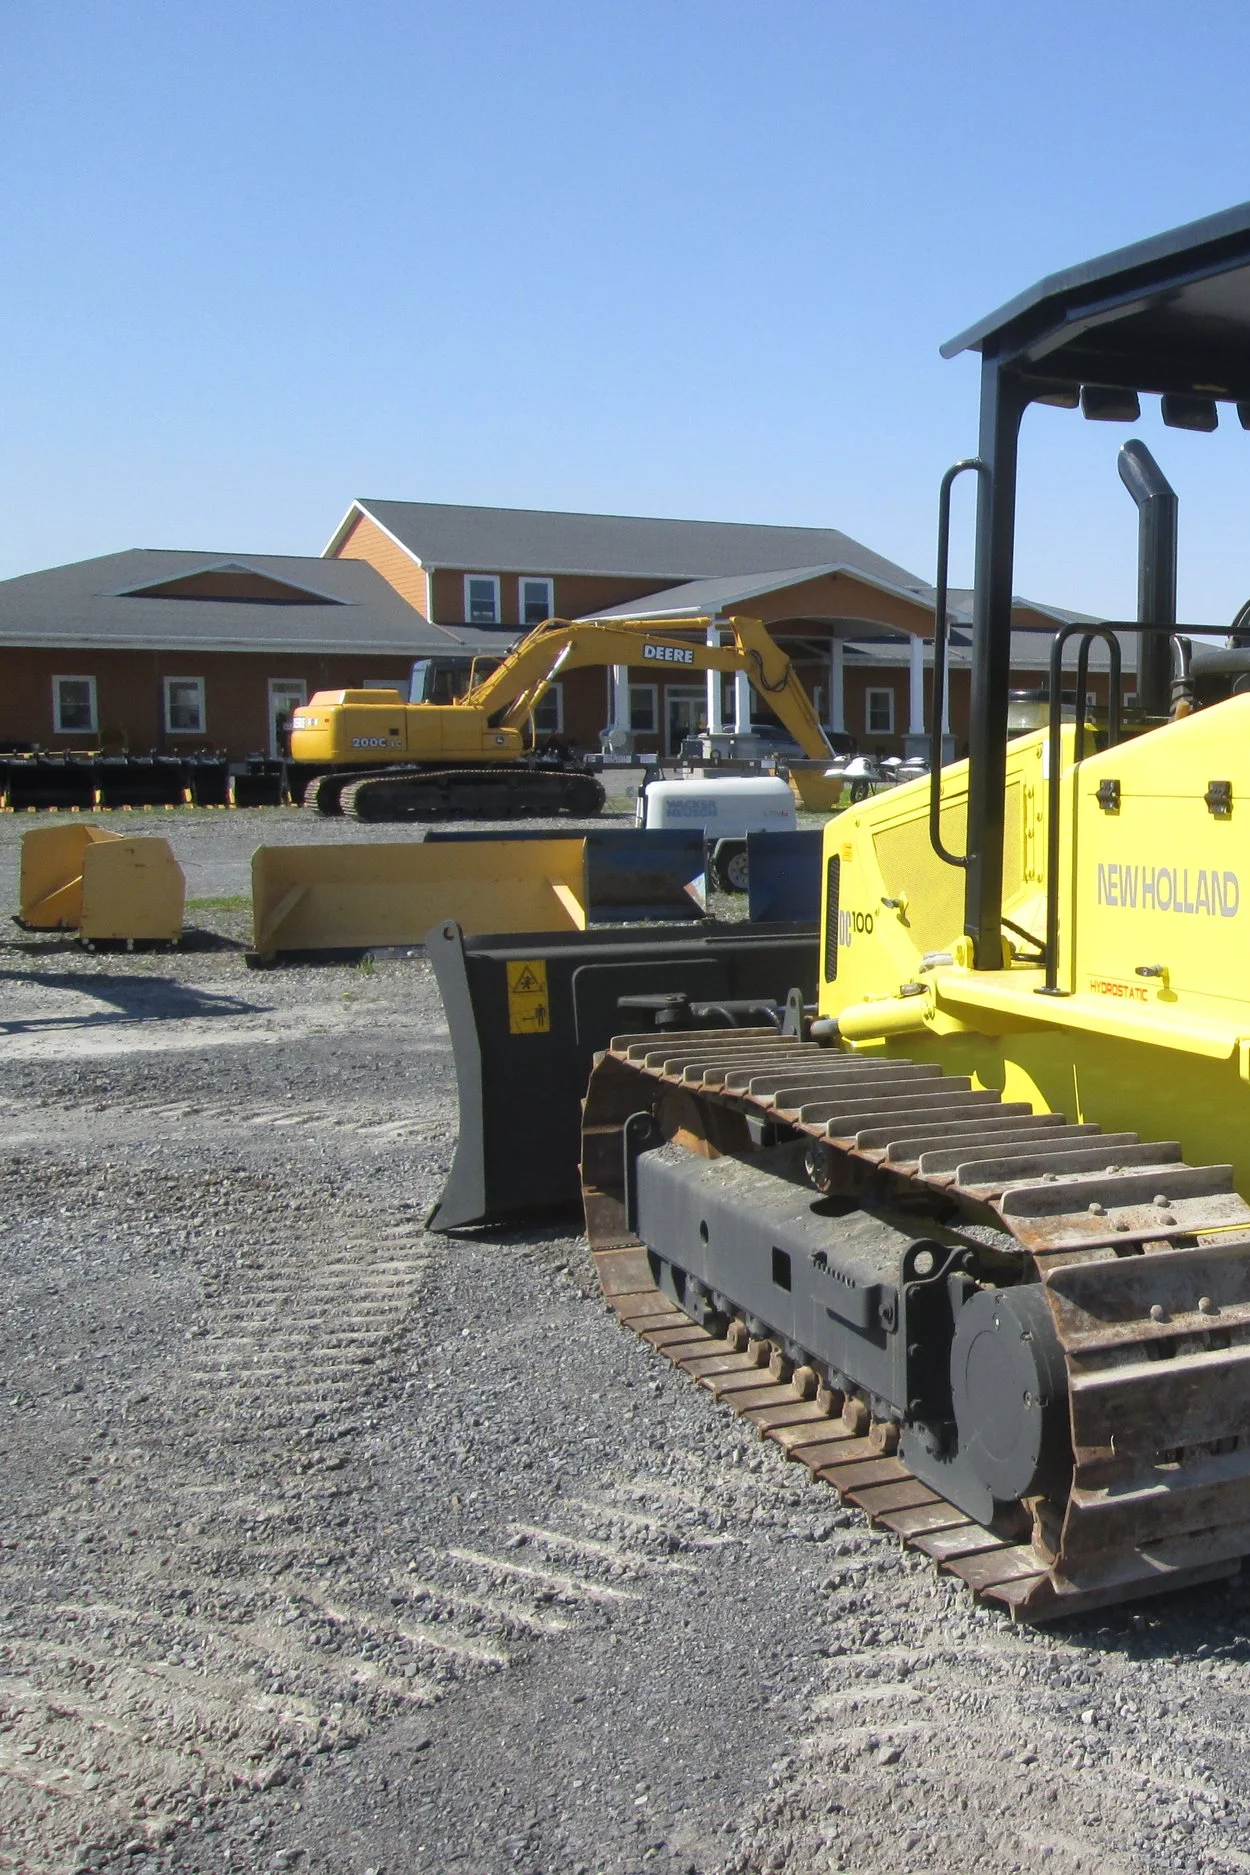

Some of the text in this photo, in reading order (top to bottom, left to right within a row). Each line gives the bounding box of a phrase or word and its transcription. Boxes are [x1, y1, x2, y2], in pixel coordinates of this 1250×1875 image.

[644, 645, 693, 663] DEERE
[352, 738, 386, 748] 200C
[1098, 862, 1240, 918] NEW HOLLAND
[1090, 979, 1149, 1002] HYDROSTATIC
